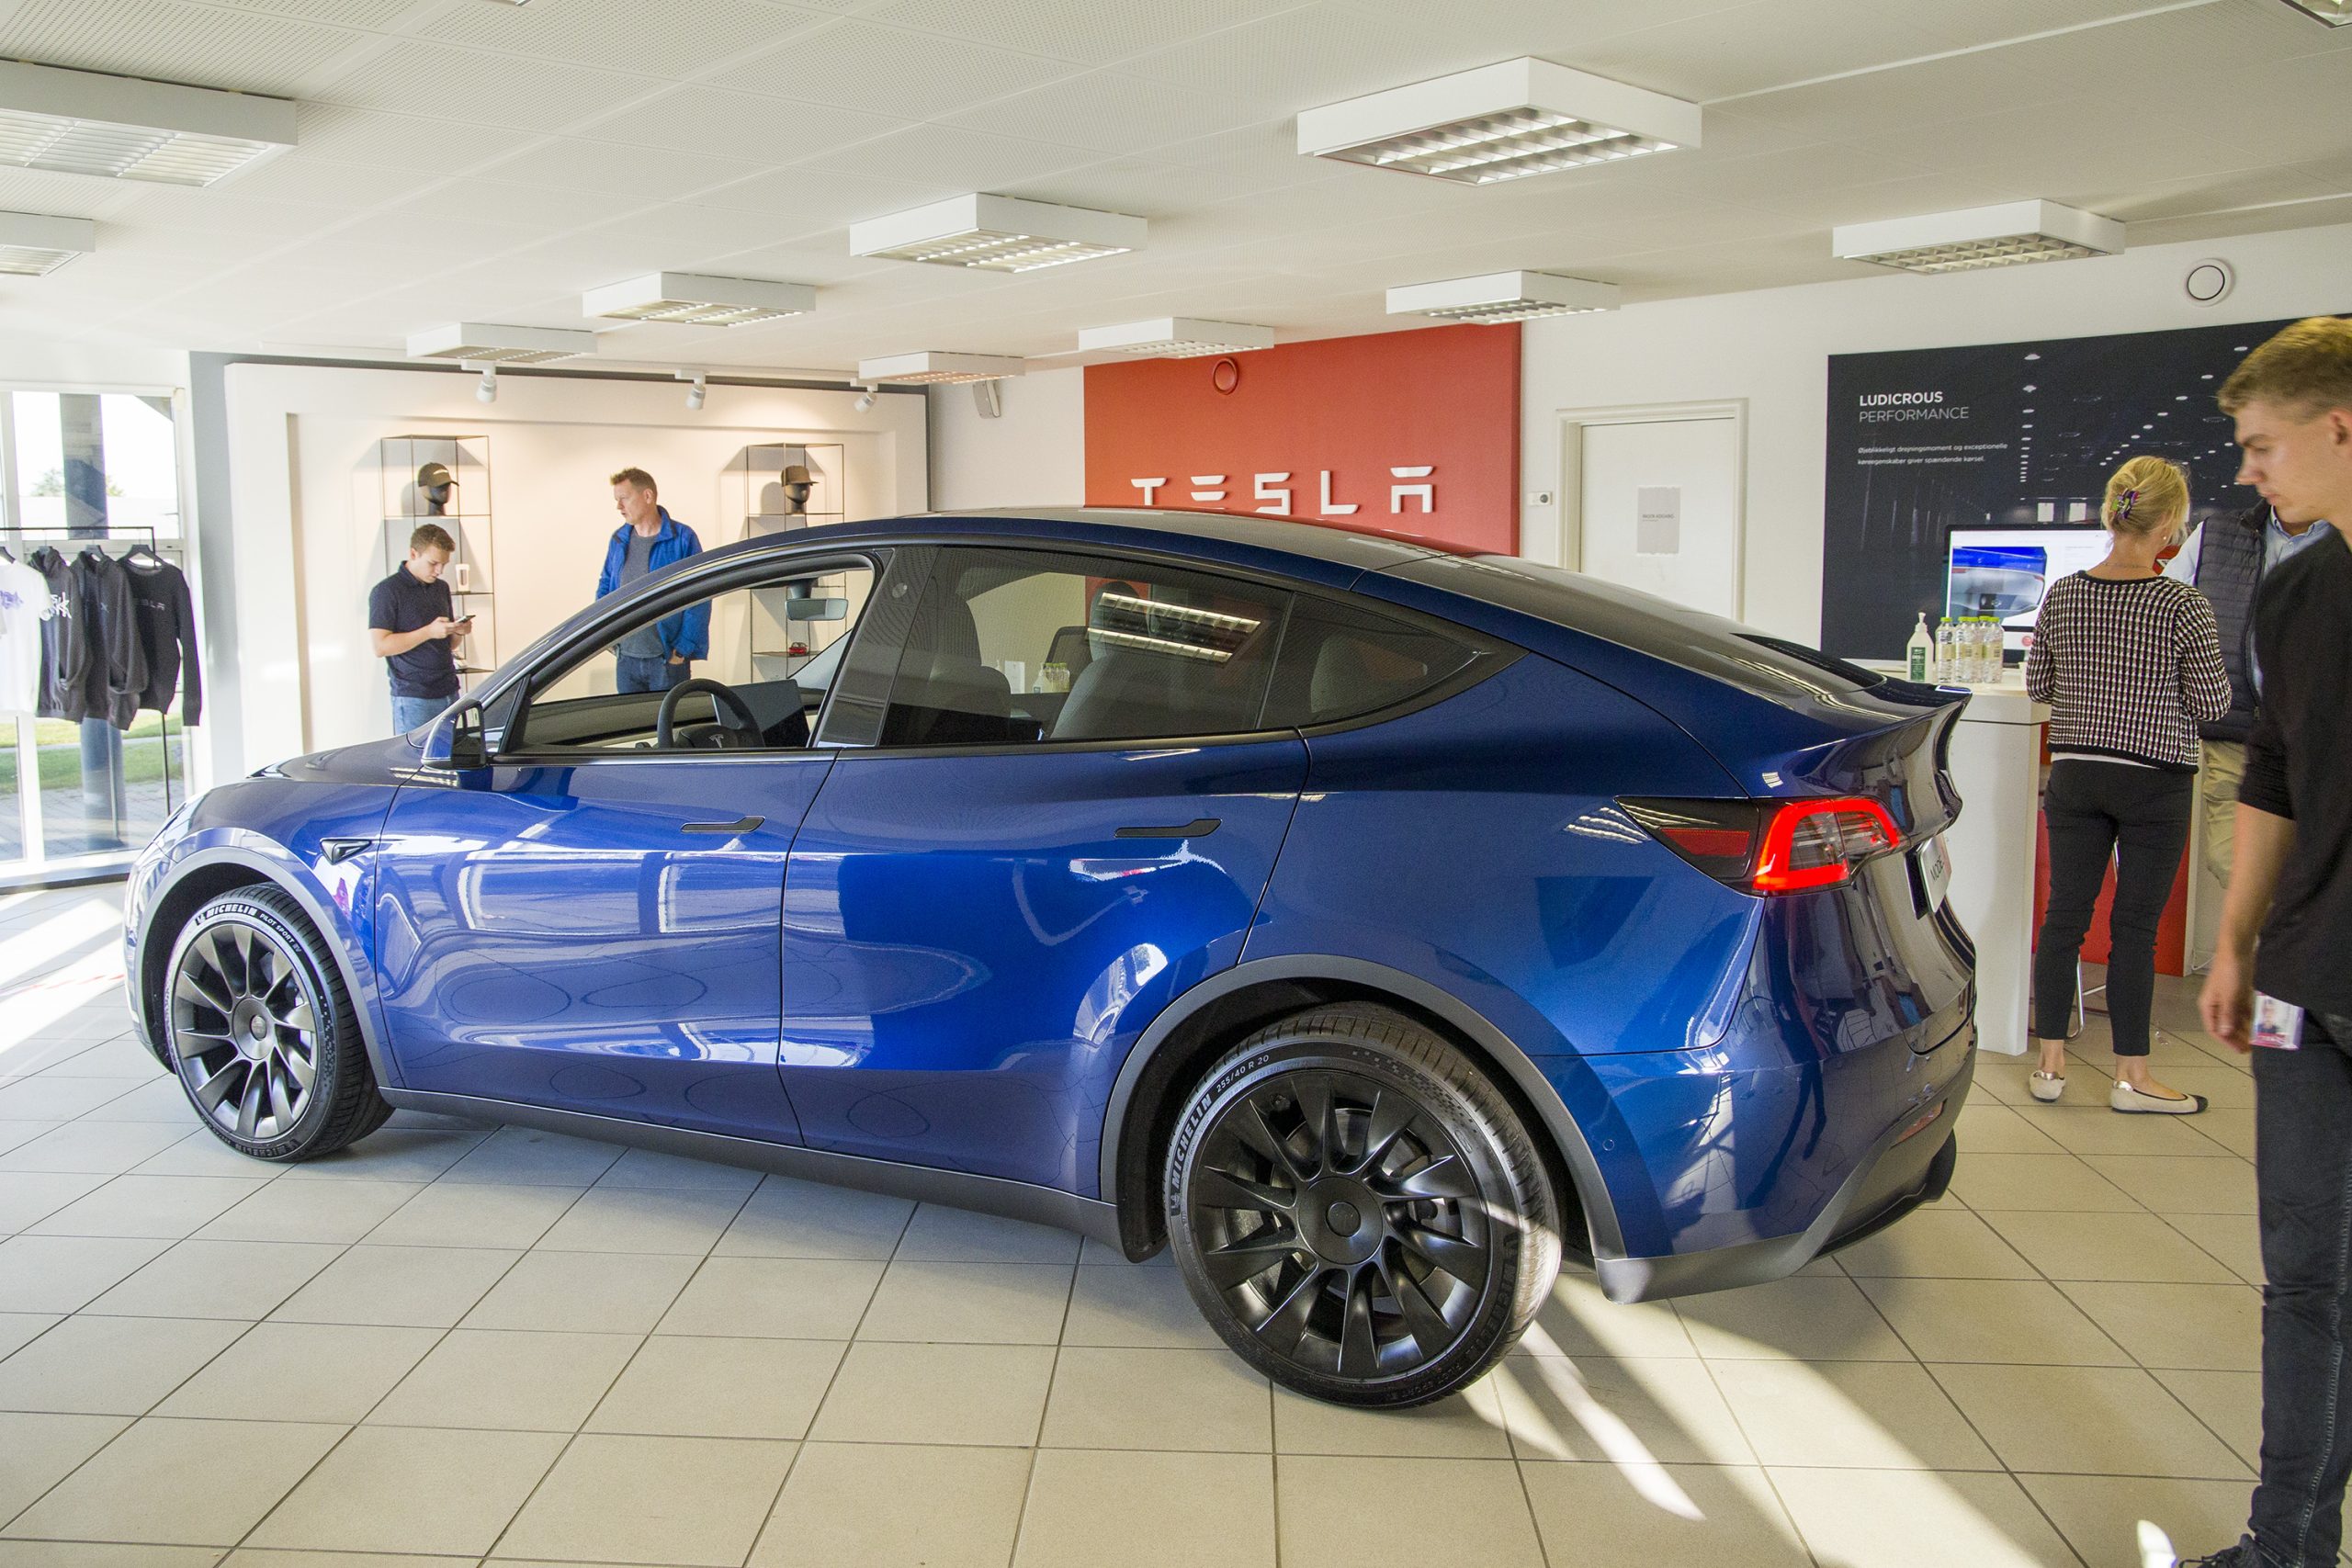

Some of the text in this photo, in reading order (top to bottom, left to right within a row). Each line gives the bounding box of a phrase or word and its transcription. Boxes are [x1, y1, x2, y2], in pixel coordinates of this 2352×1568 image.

[1859, 391, 1944, 407] LUDICROUS
[1859, 406, 1970, 423] PERFORMANCE
[1131, 466, 1434, 515] TESLA
[206, 904, 258, 919] MICHELIN
[259, 913, 277, 927] PILOT
[275, 925, 294, 944] SPORT
[1171, 1055, 1270, 1190] MICHELIN 255/40 R 20
